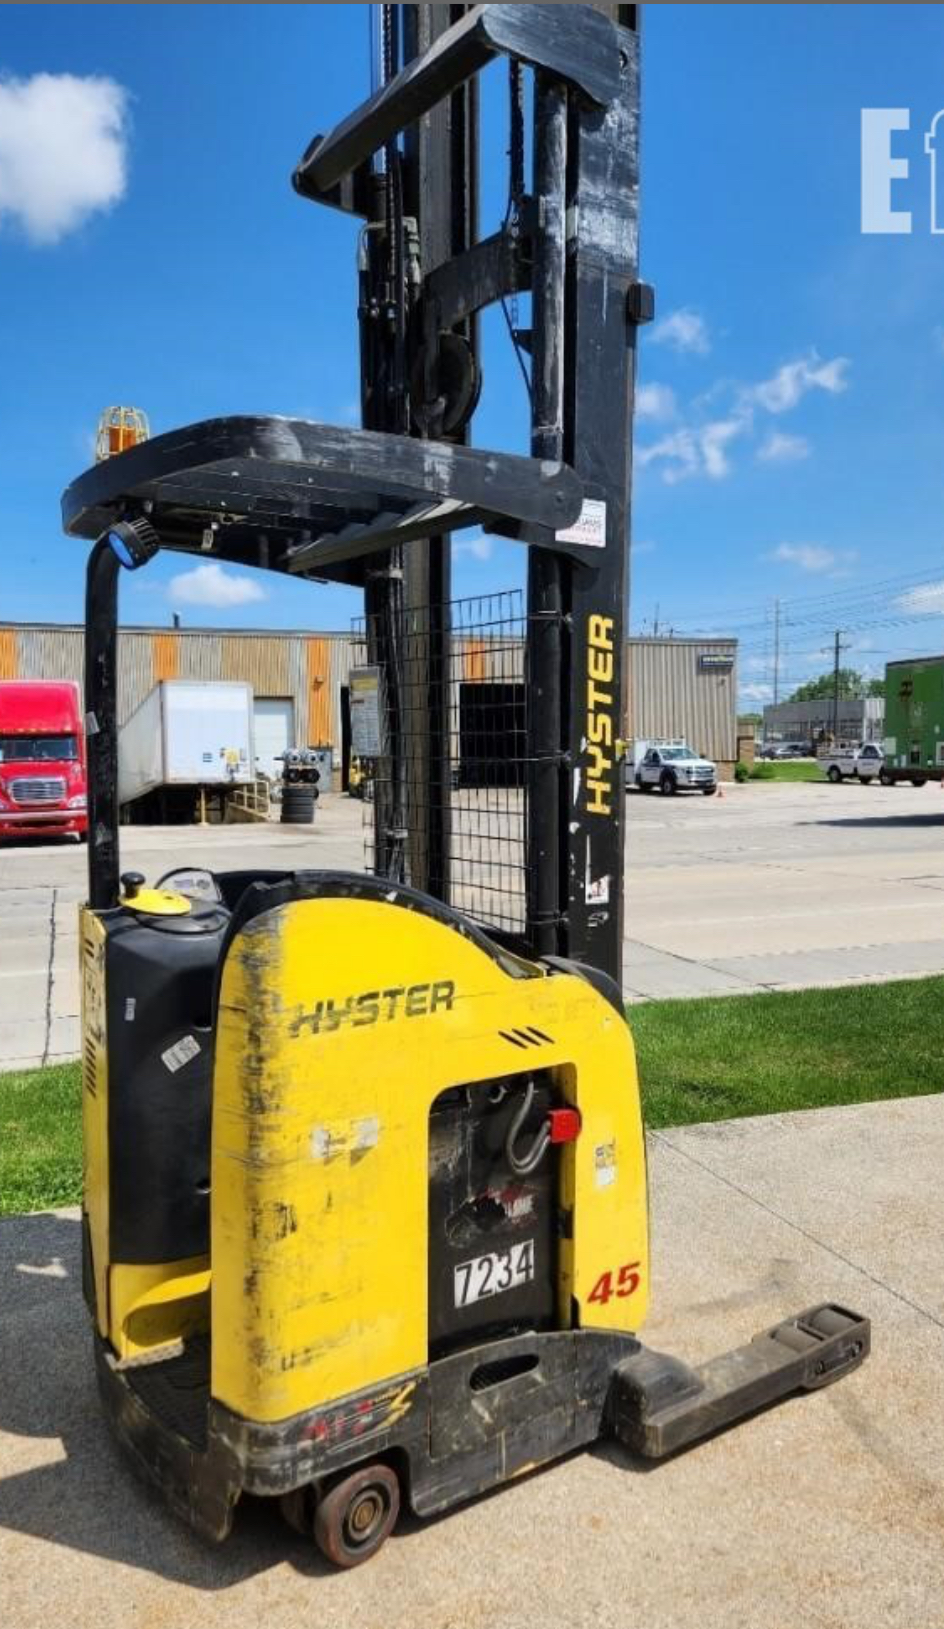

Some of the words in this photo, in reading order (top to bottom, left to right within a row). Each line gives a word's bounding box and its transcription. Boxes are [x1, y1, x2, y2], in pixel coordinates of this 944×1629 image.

[586, 614, 614, 815] HYSTER
[289, 980, 455, 1038] HYSTER
[455, 1243, 534, 1305] 7234
[587, 1261, 641, 1305] 45
